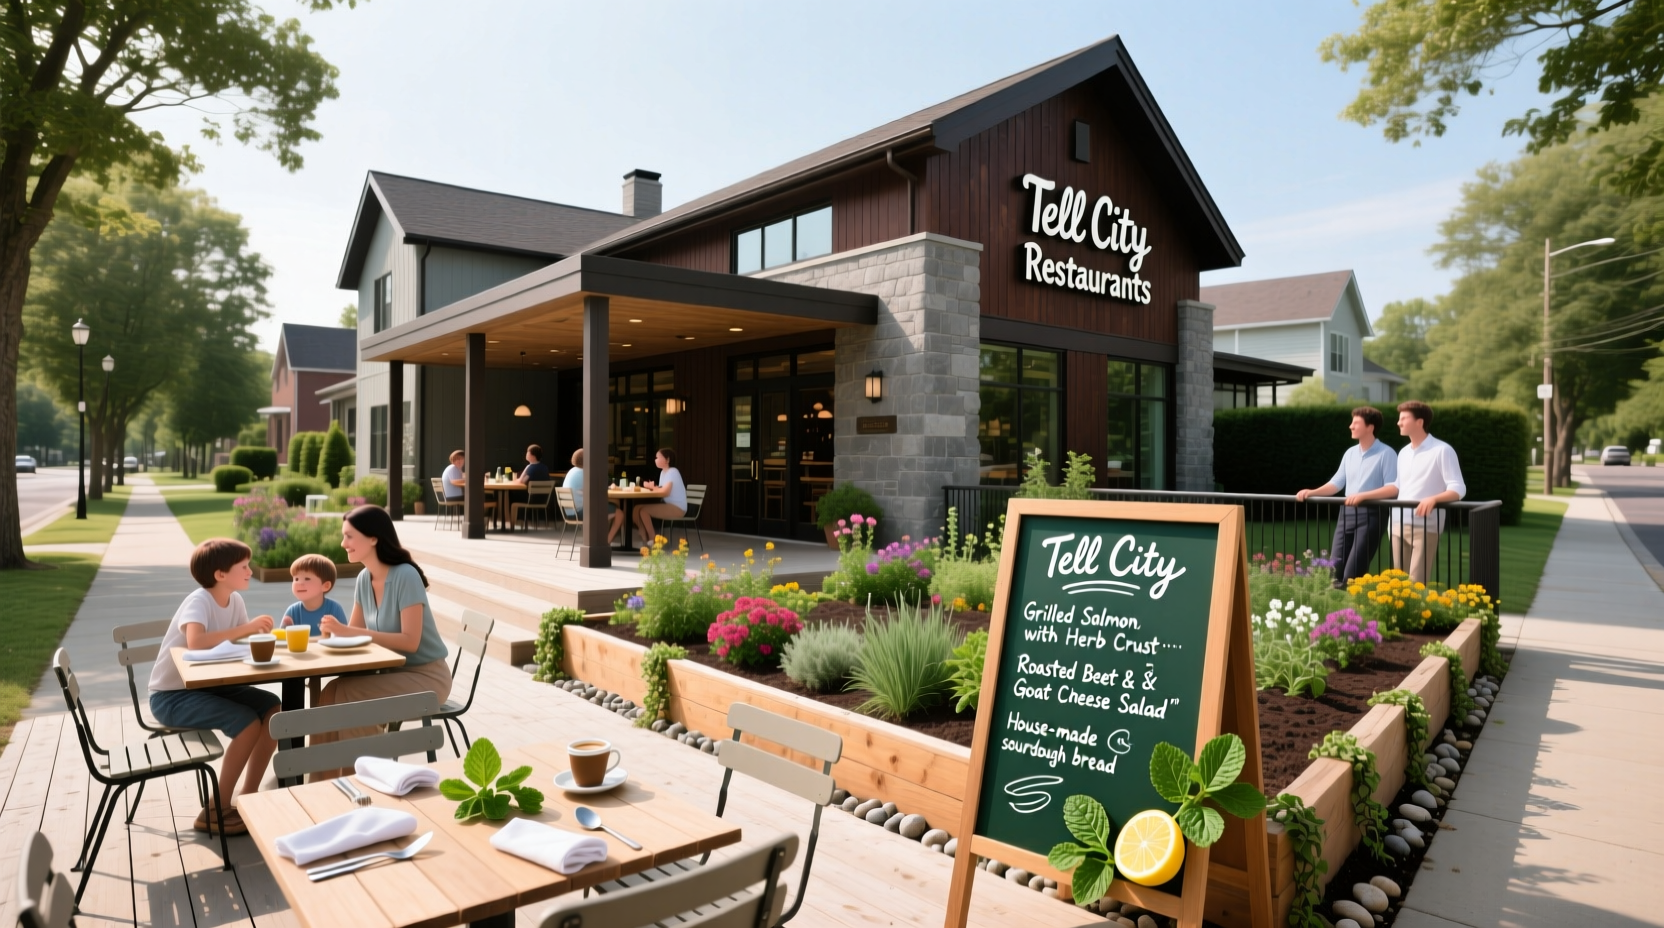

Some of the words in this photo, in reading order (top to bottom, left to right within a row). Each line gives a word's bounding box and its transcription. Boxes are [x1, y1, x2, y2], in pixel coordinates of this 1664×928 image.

[1022, 173, 1087, 243] Tell
[1091, 195, 1152, 273] City
[1024, 241, 1152, 305] Restaurants
[1041, 532, 1103, 579] Tell
[1108, 534, 1187, 600] City
[1023, 600, 1076, 624] Grilled
[1024, 625, 1058, 643] with
[1065, 627, 1107, 649] Herb
[1016, 653, 1078, 680] Roasted
[1081, 663, 1119, 687] Beet
[1121, 669, 1135, 690] &
[1013, 677, 1053, 700] Goat
[1057, 684, 1111, 710] Cheese
[1006, 711, 1098, 747] House-made
[1071, 746, 1118, 775] bread
